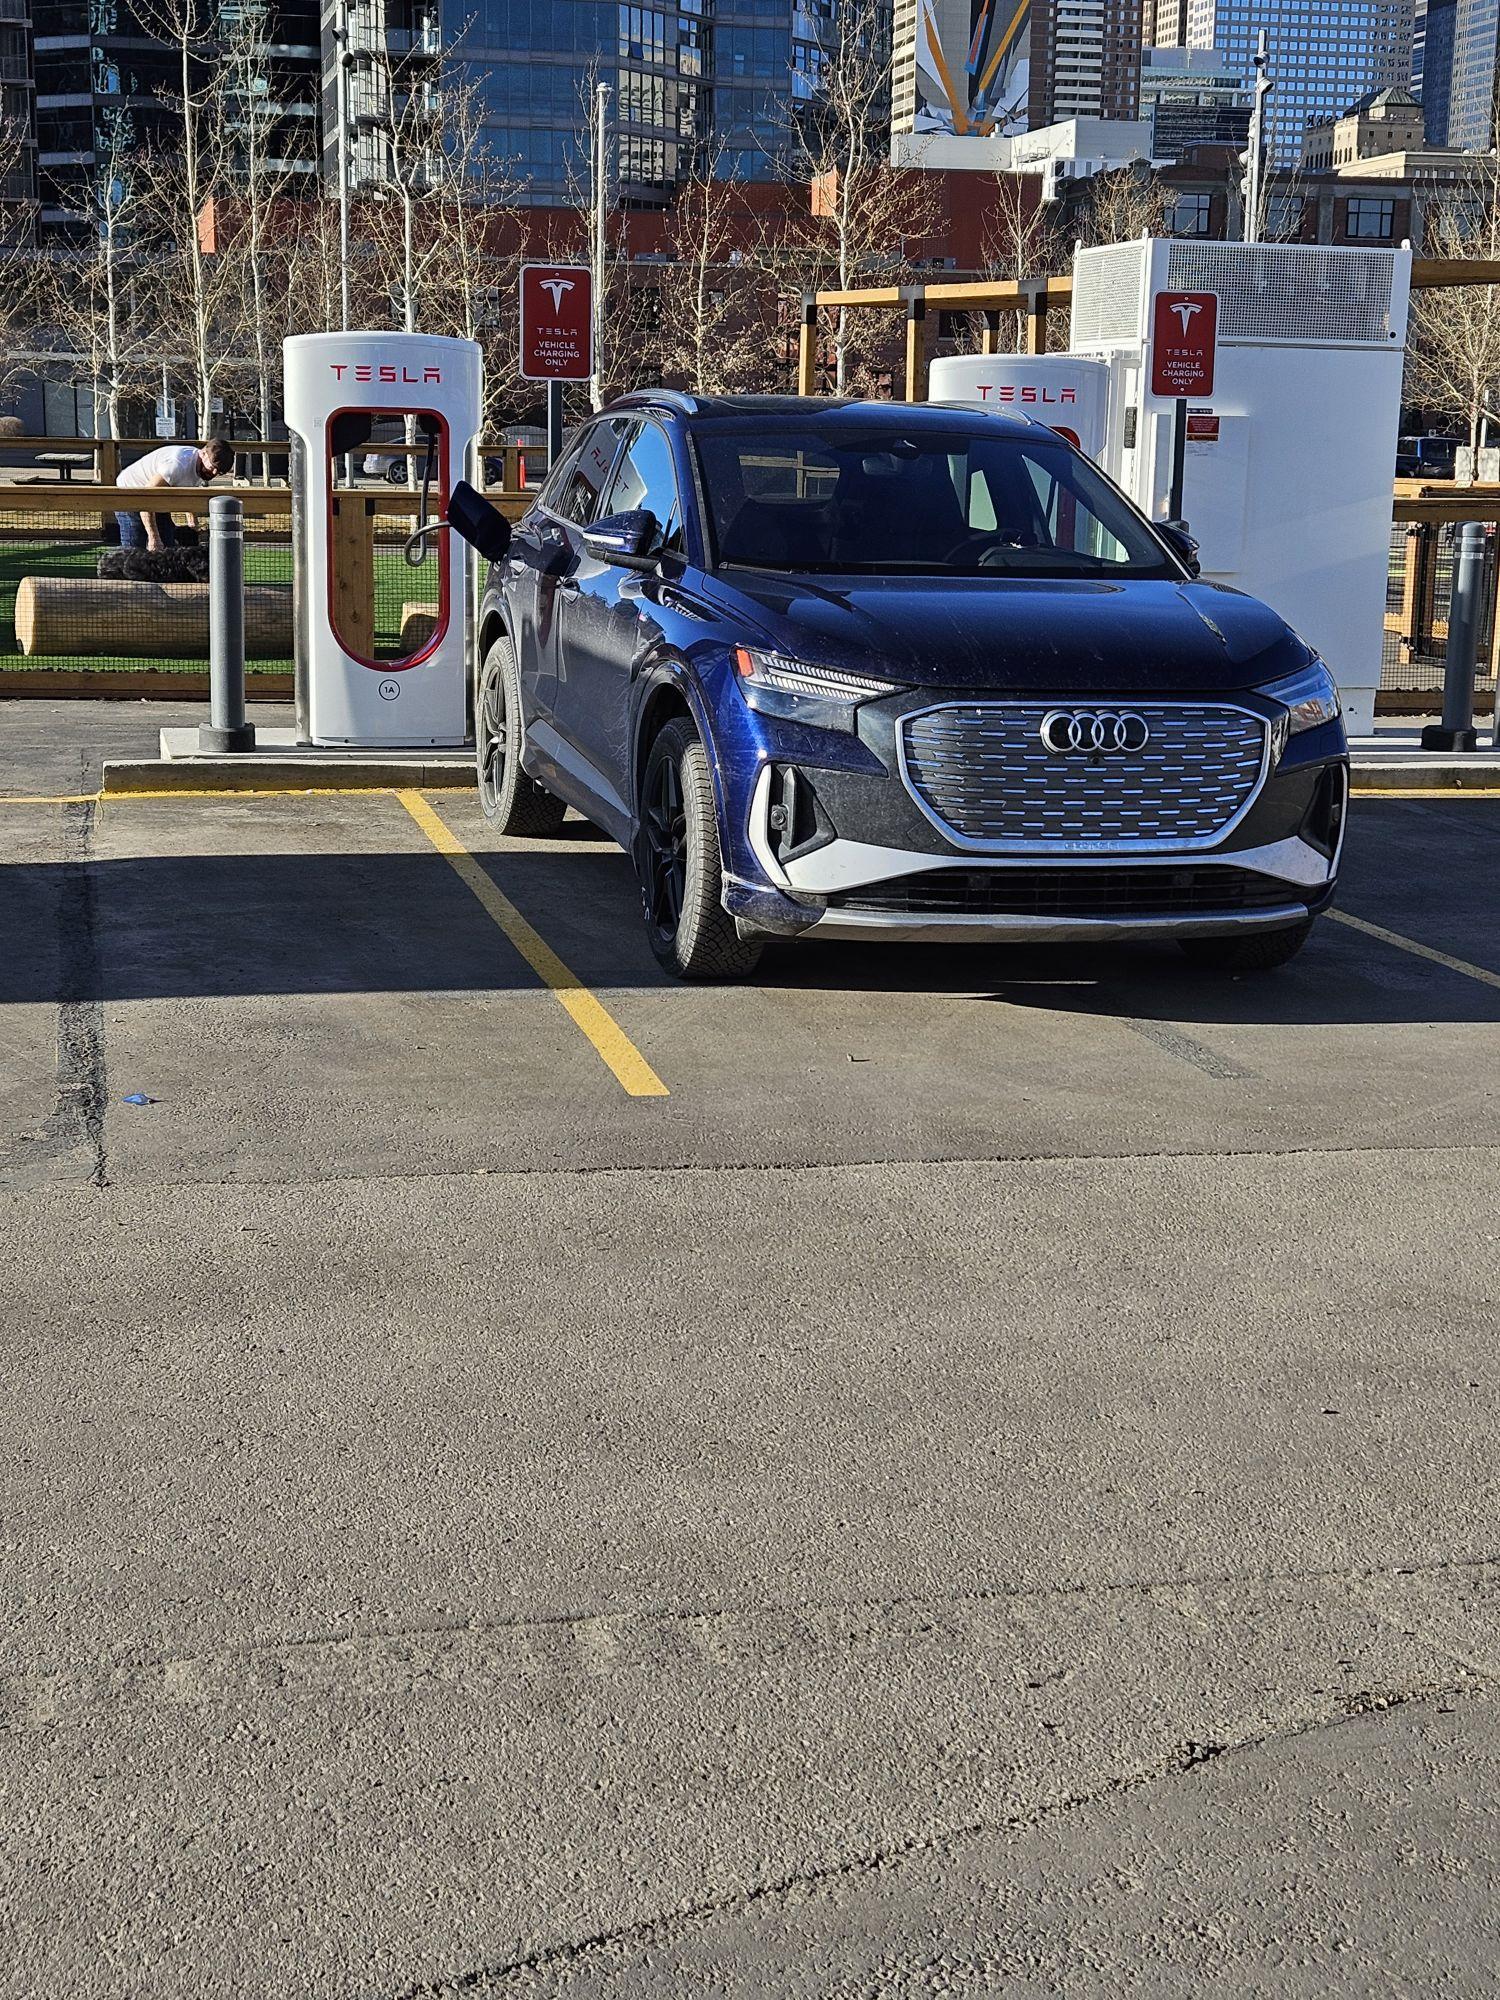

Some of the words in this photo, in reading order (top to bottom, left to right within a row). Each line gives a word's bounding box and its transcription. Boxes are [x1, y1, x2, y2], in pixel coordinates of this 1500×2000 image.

[536, 327, 578, 336] TESLA
[538, 340, 576, 350] VEHICLE
[533, 349, 580, 358] CHARGING
[1165, 348, 1203, 356] TESLA
[544, 358, 569, 367] ONLY
[1166, 361, 1201, 369] VEHICLE
[329, 364, 441, 384] TESLA
[1161, 369, 1205, 378] CHARGING
[1171, 378, 1194, 386] ONLY
[976, 385, 1076, 404] TESLA
[384, 686, 395, 694] 1A
